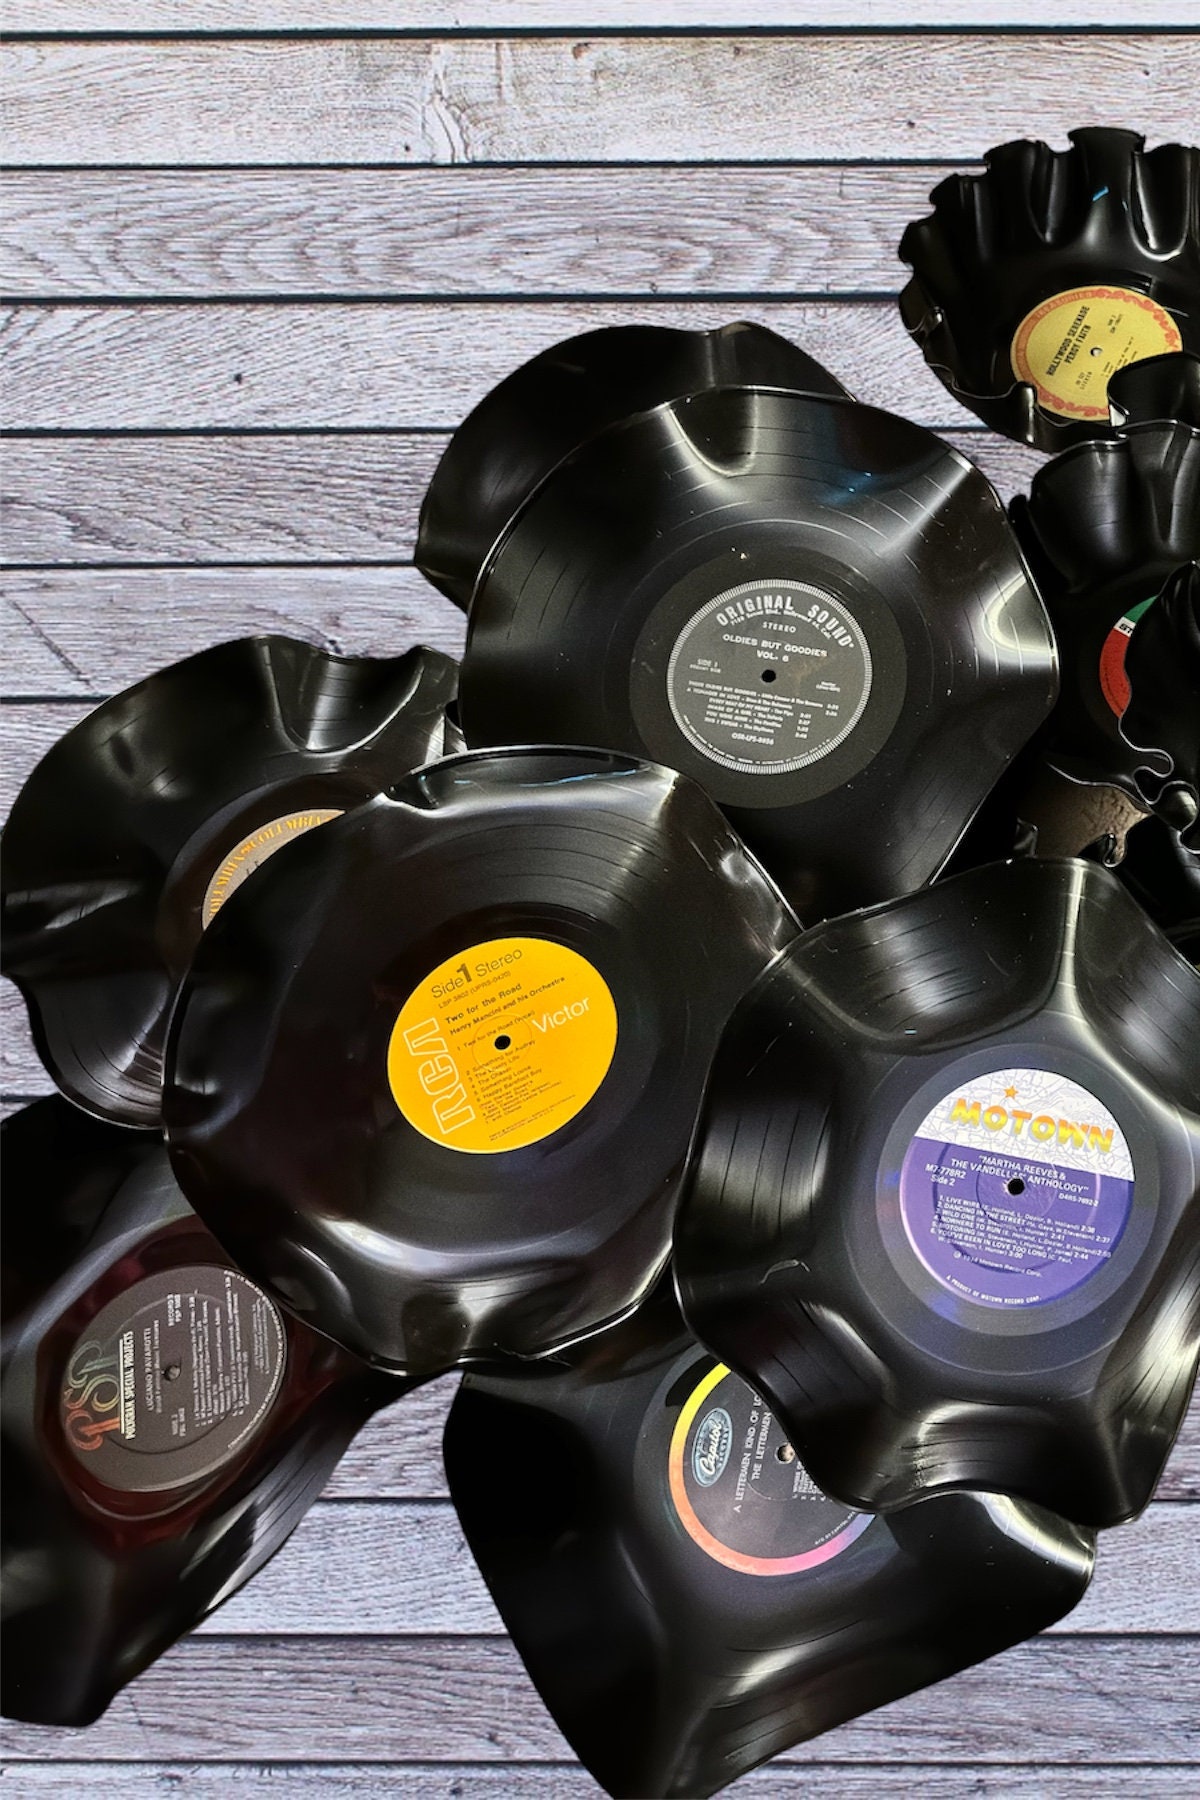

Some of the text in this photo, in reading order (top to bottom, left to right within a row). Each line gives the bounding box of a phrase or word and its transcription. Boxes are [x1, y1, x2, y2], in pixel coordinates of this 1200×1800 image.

[716, 595, 851, 647] ORIGINAL SOUND
[762, 621, 796, 633] STEREO
[722, 634, 827, 656] OLDIES BUT GOODIES
[756, 650, 778, 660] VOL.
[474, 949, 522, 977] Stereo
[444, 983, 521, 1024] Two for the Road
[449, 976, 565, 1035] Henry Mancini and his Orchestra
[531, 998, 588, 1032] Victor
[403, 1017, 476, 1135] RCA
[951, 1098, 1114, 1153] MOTOWN
[951, 1158, 968, 1169] THE
[1023, 1164, 1058, 1178] REEVES
[1058, 1172, 1066, 1180] &
[930, 1174, 955, 1186] Side 2
[750, 1410, 759, 1423] OF
[700, 1420, 722, 1475] Capitol
[745, 1424, 755, 1449] KIND
[752, 1412, 772, 1480] THE LETTERMEN
[735, 1452, 751, 1501] LETTERMEN
[734, 1505, 742, 1513] A
